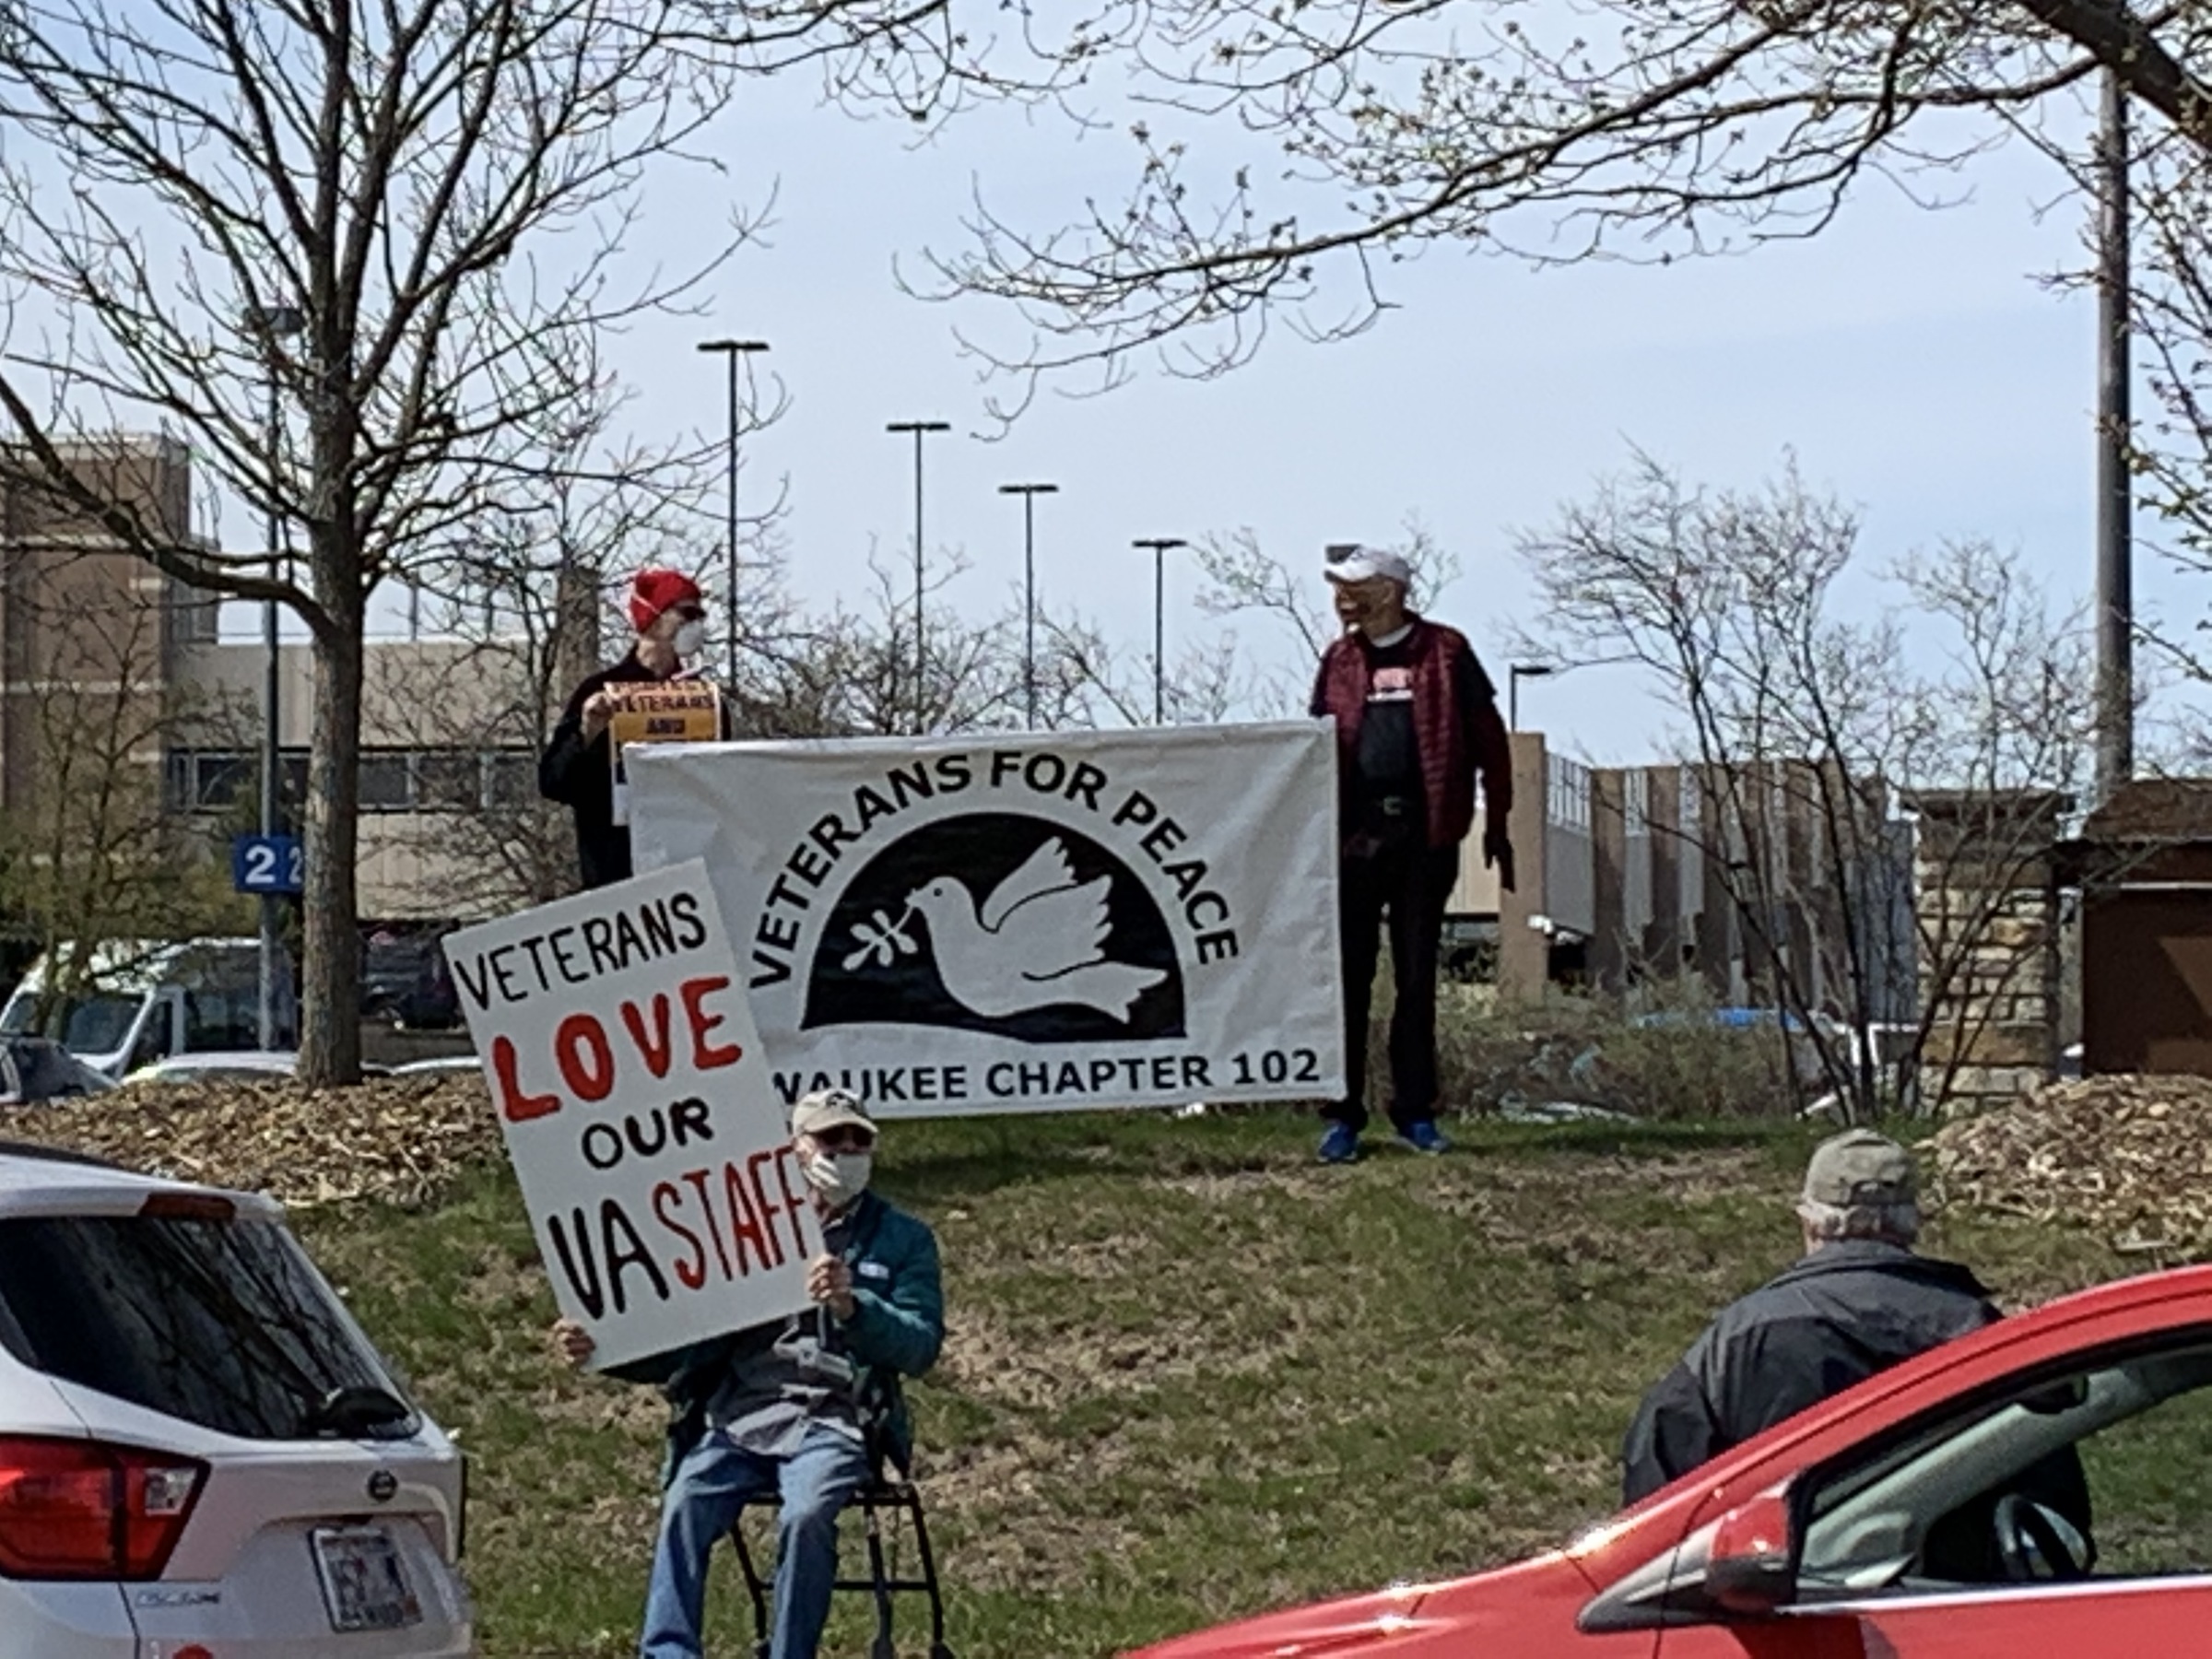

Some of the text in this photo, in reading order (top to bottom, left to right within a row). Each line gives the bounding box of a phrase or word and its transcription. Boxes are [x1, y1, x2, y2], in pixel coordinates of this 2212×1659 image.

[244, 845, 276, 884] 2
[748, 750, 1239, 989] VETERANS FOR PEACE
[454, 892, 707, 1010] VETERANS
[492, 976, 743, 1123] LOVE
[985, 1054, 1213, 1097] CHAPTER
[1231, 1049, 1320, 1086] 102
[582, 1097, 714, 1169] OUR
[547, 1146, 807, 1320] VA STAFF
